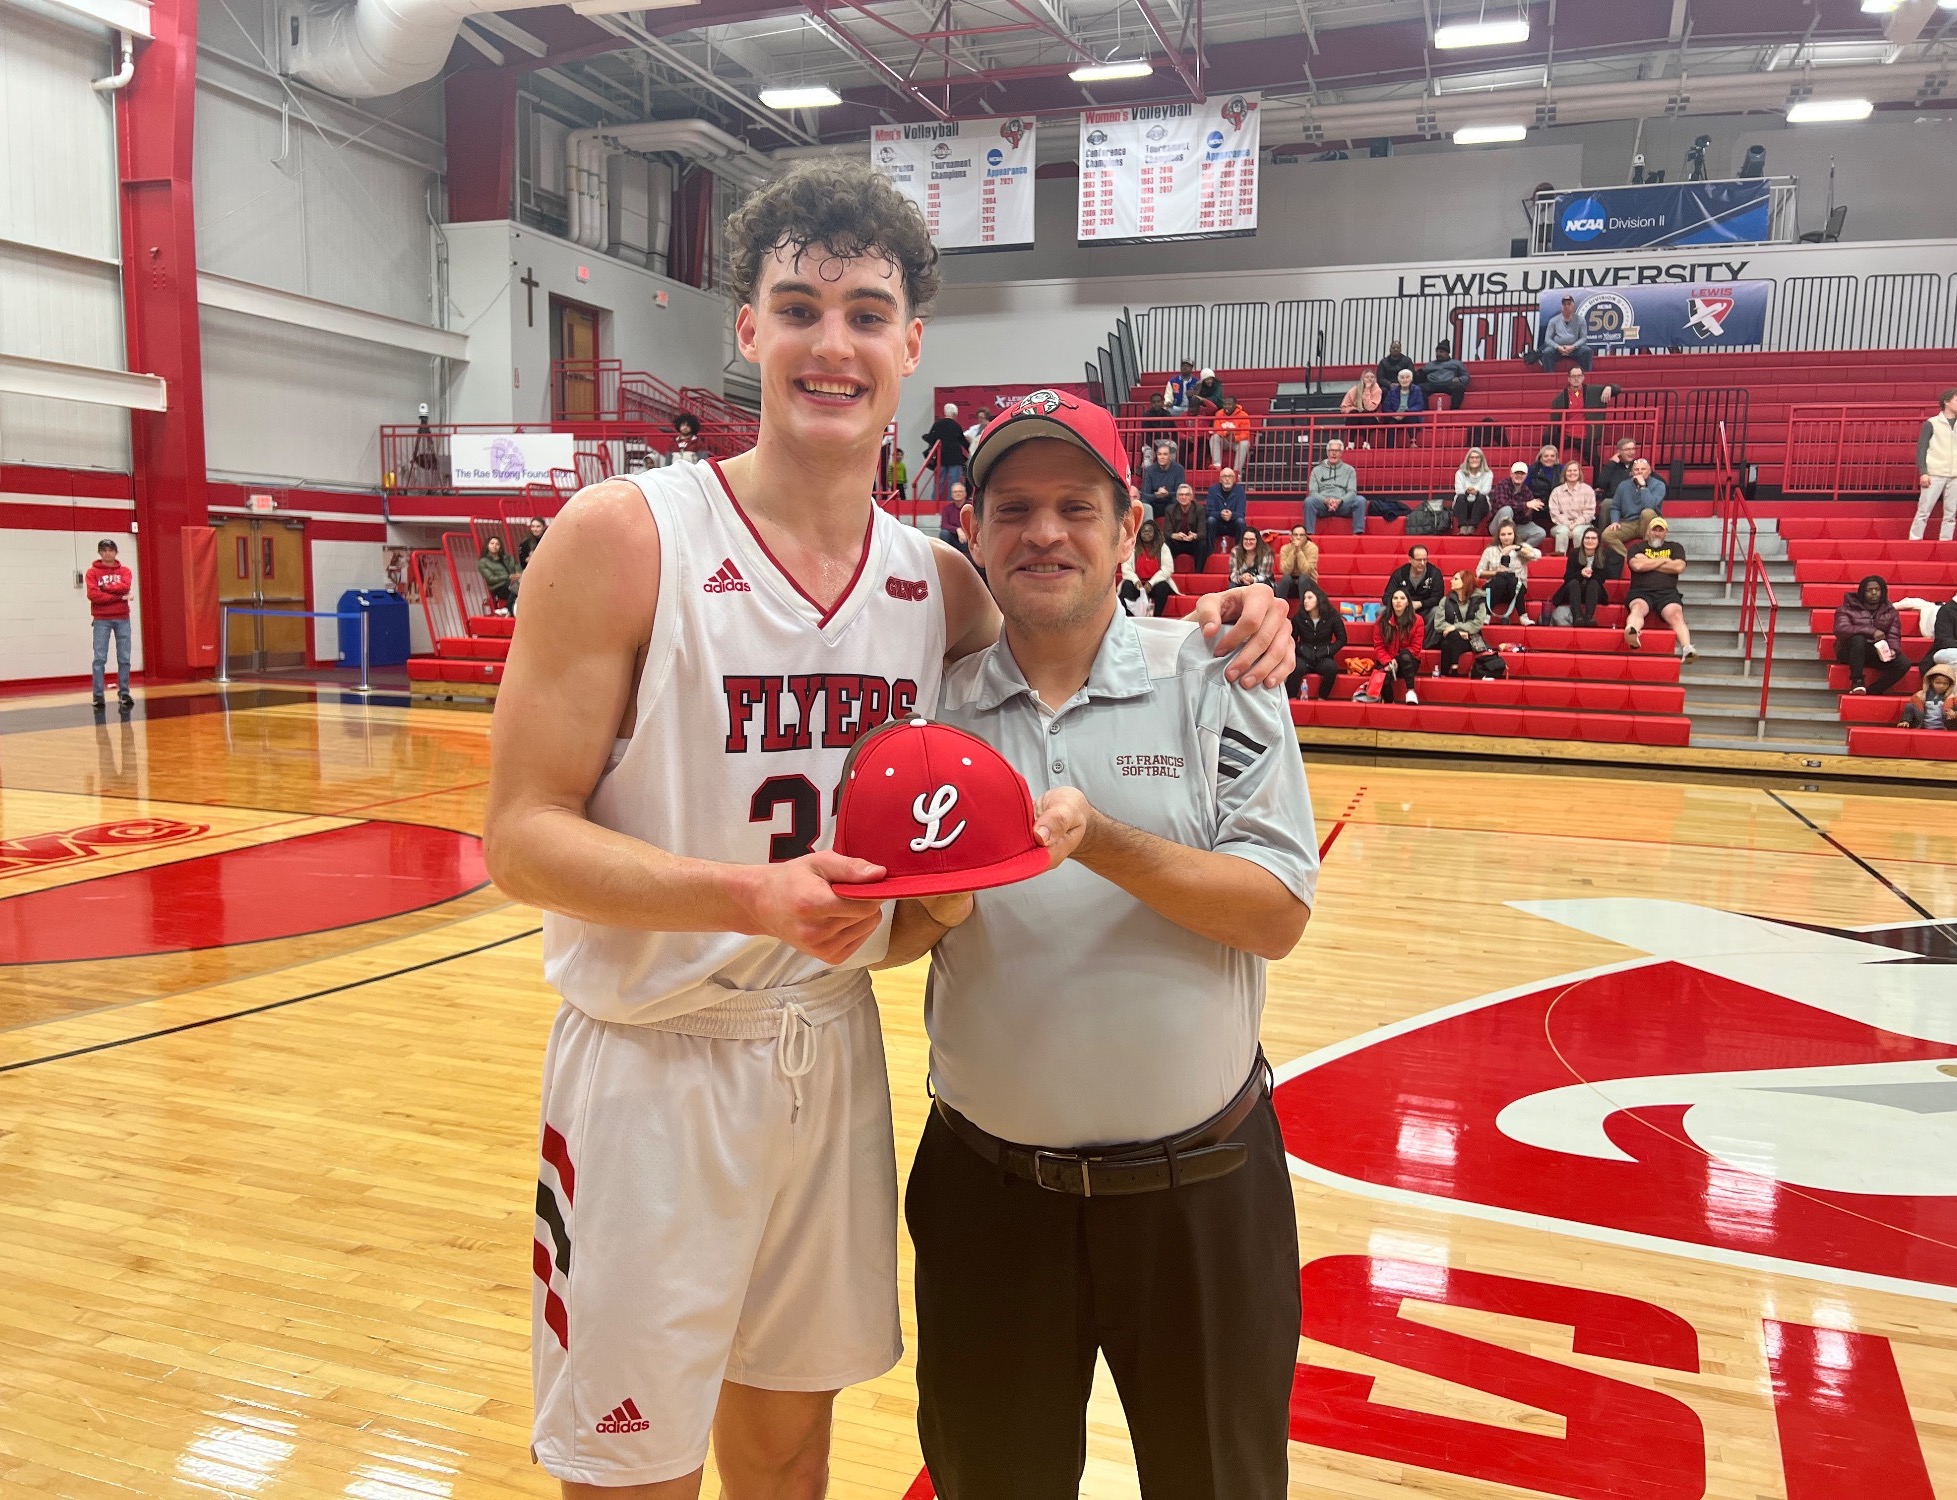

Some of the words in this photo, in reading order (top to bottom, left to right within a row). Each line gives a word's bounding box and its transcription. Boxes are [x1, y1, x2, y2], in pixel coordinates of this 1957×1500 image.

[1085, 110, 1129, 124] Women's
[1131, 103, 1192, 121] Volleyball
[875, 128, 901, 141] Men's
[903, 122, 959, 140] Volleyball
[931, 158, 972, 169] Tournament
[931, 170, 967, 180] Champions
[986, 166, 1028, 177] Appearance
[1565, 219, 1604, 232] NCAA
[1609, 216, 1655, 230] Division
[1659, 215, 1665, 226] II
[1398, 272, 1508, 299] LEWIS
[1522, 261, 1751, 293] UNIVERSITY
[1691, 288, 1733, 297] LEWIS
[1589, 310, 1618, 331] 50
[455, 469, 471, 478] The
[473, 469, 490, 478] Rae
[492, 469, 520, 480] Strong
[703, 579, 751, 593] adidas
[885, 576, 928, 602] GLVC
[722, 673, 918, 753] FLYERS
[1116, 755, 1134, 765] ST.
[1136, 755, 1184, 767] FRANCIS
[1122, 766, 1180, 778] SOFTBALL
[910, 784, 967, 852] L
[596, 1420, 650, 1433] adidas
